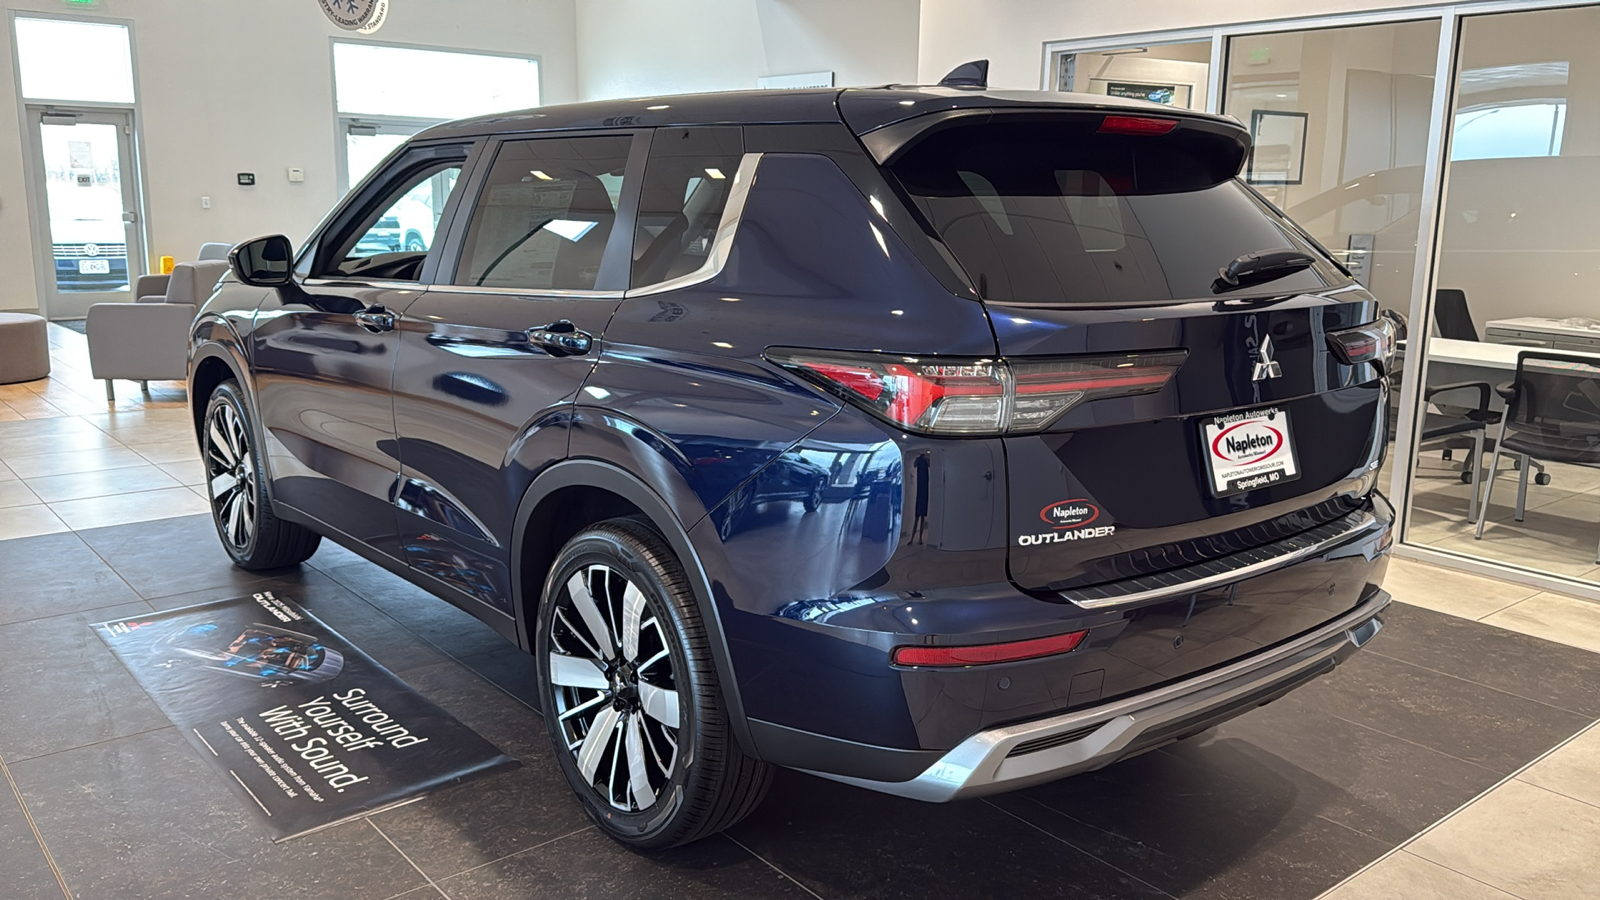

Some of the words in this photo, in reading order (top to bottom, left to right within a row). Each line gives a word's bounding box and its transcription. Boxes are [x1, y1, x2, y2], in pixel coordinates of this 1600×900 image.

[367, 2, 386, 30] STANDARD
[1226, 433, 1273, 455] Napleton
[1236, 476, 1269, 490] Springfield,
[1269, 472, 1280, 482] MO
[1053, 506, 1088, 518] Napleton
[1018, 525, 1115, 546] OUTLANDER
[252, 592, 292, 623] OUTLANDER
[298, 696, 384, 752] Yourself
[333, 688, 428, 749] Surround
[259, 705, 312, 741] With
[291, 737, 369, 793] Sound.
